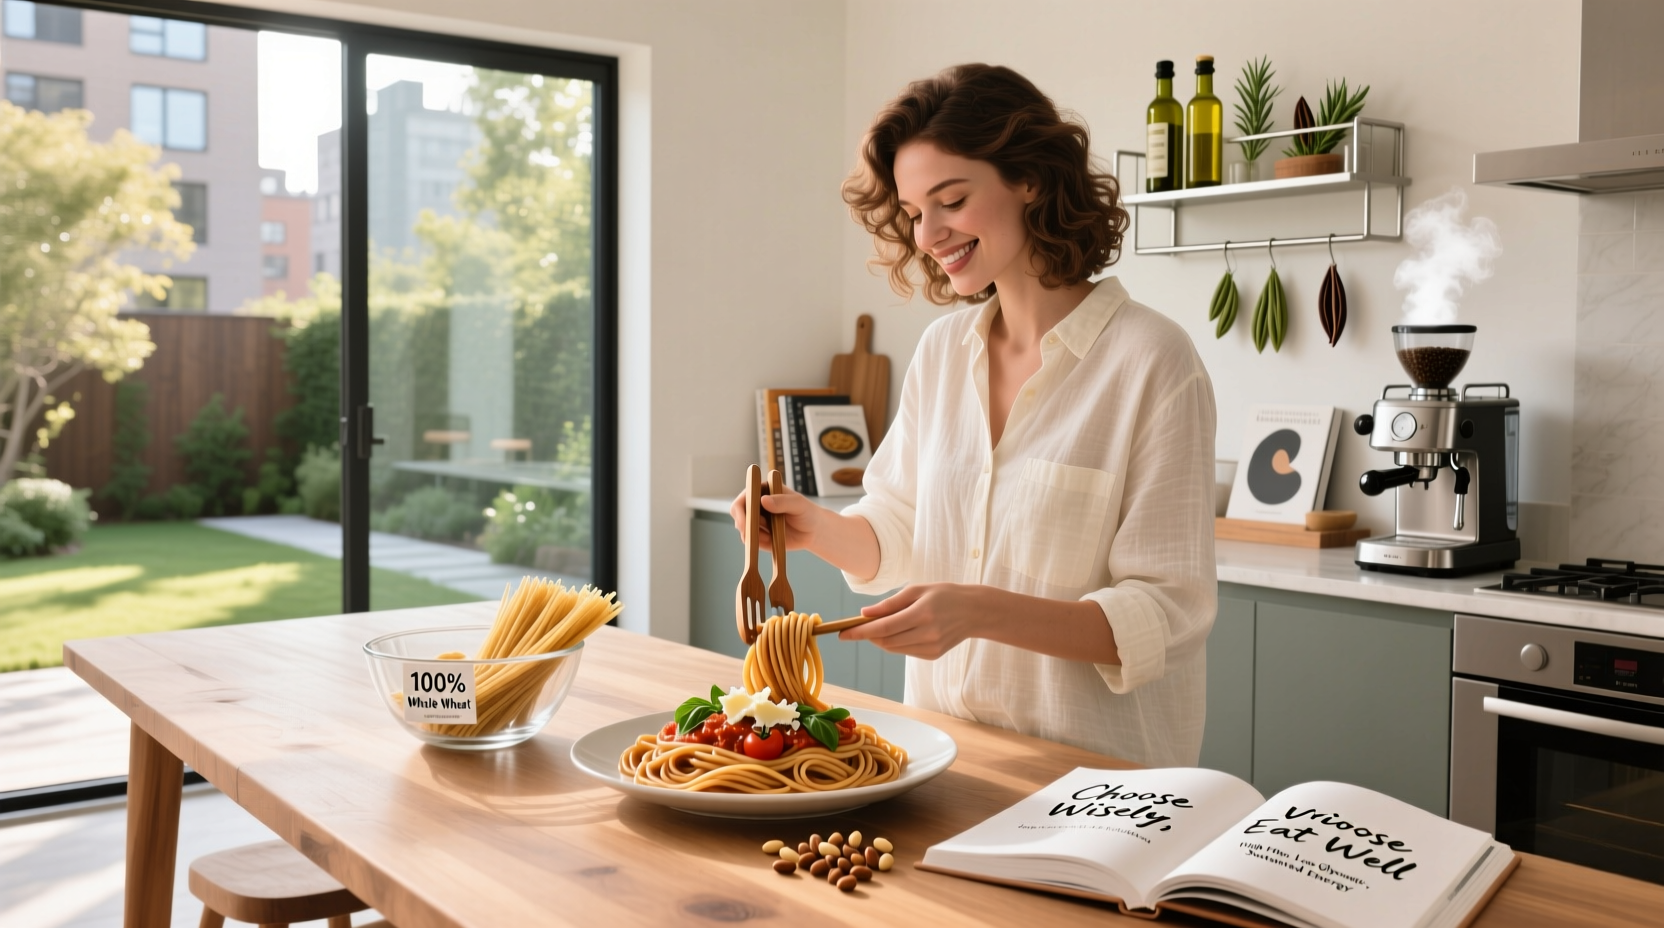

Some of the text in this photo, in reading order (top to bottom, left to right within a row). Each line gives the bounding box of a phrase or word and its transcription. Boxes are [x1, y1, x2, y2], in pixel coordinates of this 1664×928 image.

[410, 671, 466, 694] 100%
[440, 697, 472, 710] Wheat
[1071, 784, 1193, 808] Choose
[1048, 802, 1172, 832] Wisely,
[1243, 818, 1417, 881] Eat Well
